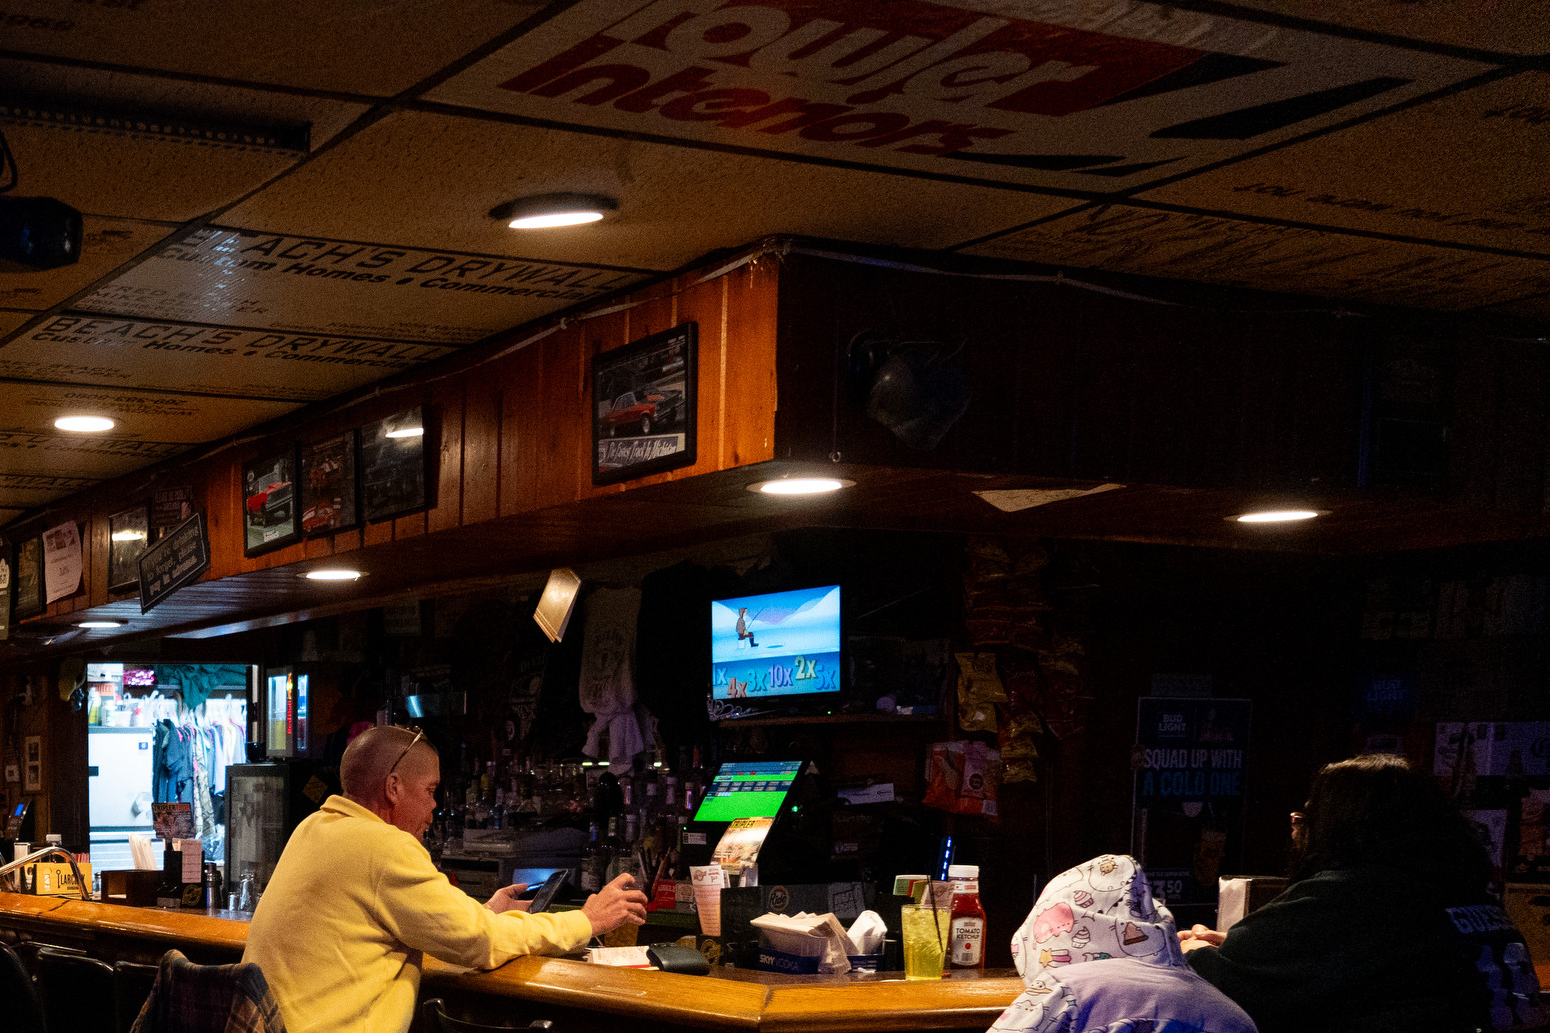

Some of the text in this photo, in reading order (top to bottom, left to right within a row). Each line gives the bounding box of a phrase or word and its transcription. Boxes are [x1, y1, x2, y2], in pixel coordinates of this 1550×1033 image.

[282, 262, 392, 284] Homes
[405, 256, 632, 291] DRYWALL
[44, 317, 241, 345] BEACH'S
[246, 335, 443, 362] DRYWALL
[144, 340, 237, 355] Homes
[769, 664, 794, 689] 10x
[794, 656, 818, 681] 2x
[1158, 722, 1187, 734] LIGHT
[1162, 714, 1183, 724] BUD
[1143, 749, 1243, 771] SQUAD UP WITH
[1142, 771, 1241, 798] A COLD ONE
[956, 927, 981, 935] TOMATO
[956, 933, 981, 941] KETCHUP
[759, 953, 776, 967] SKYY
